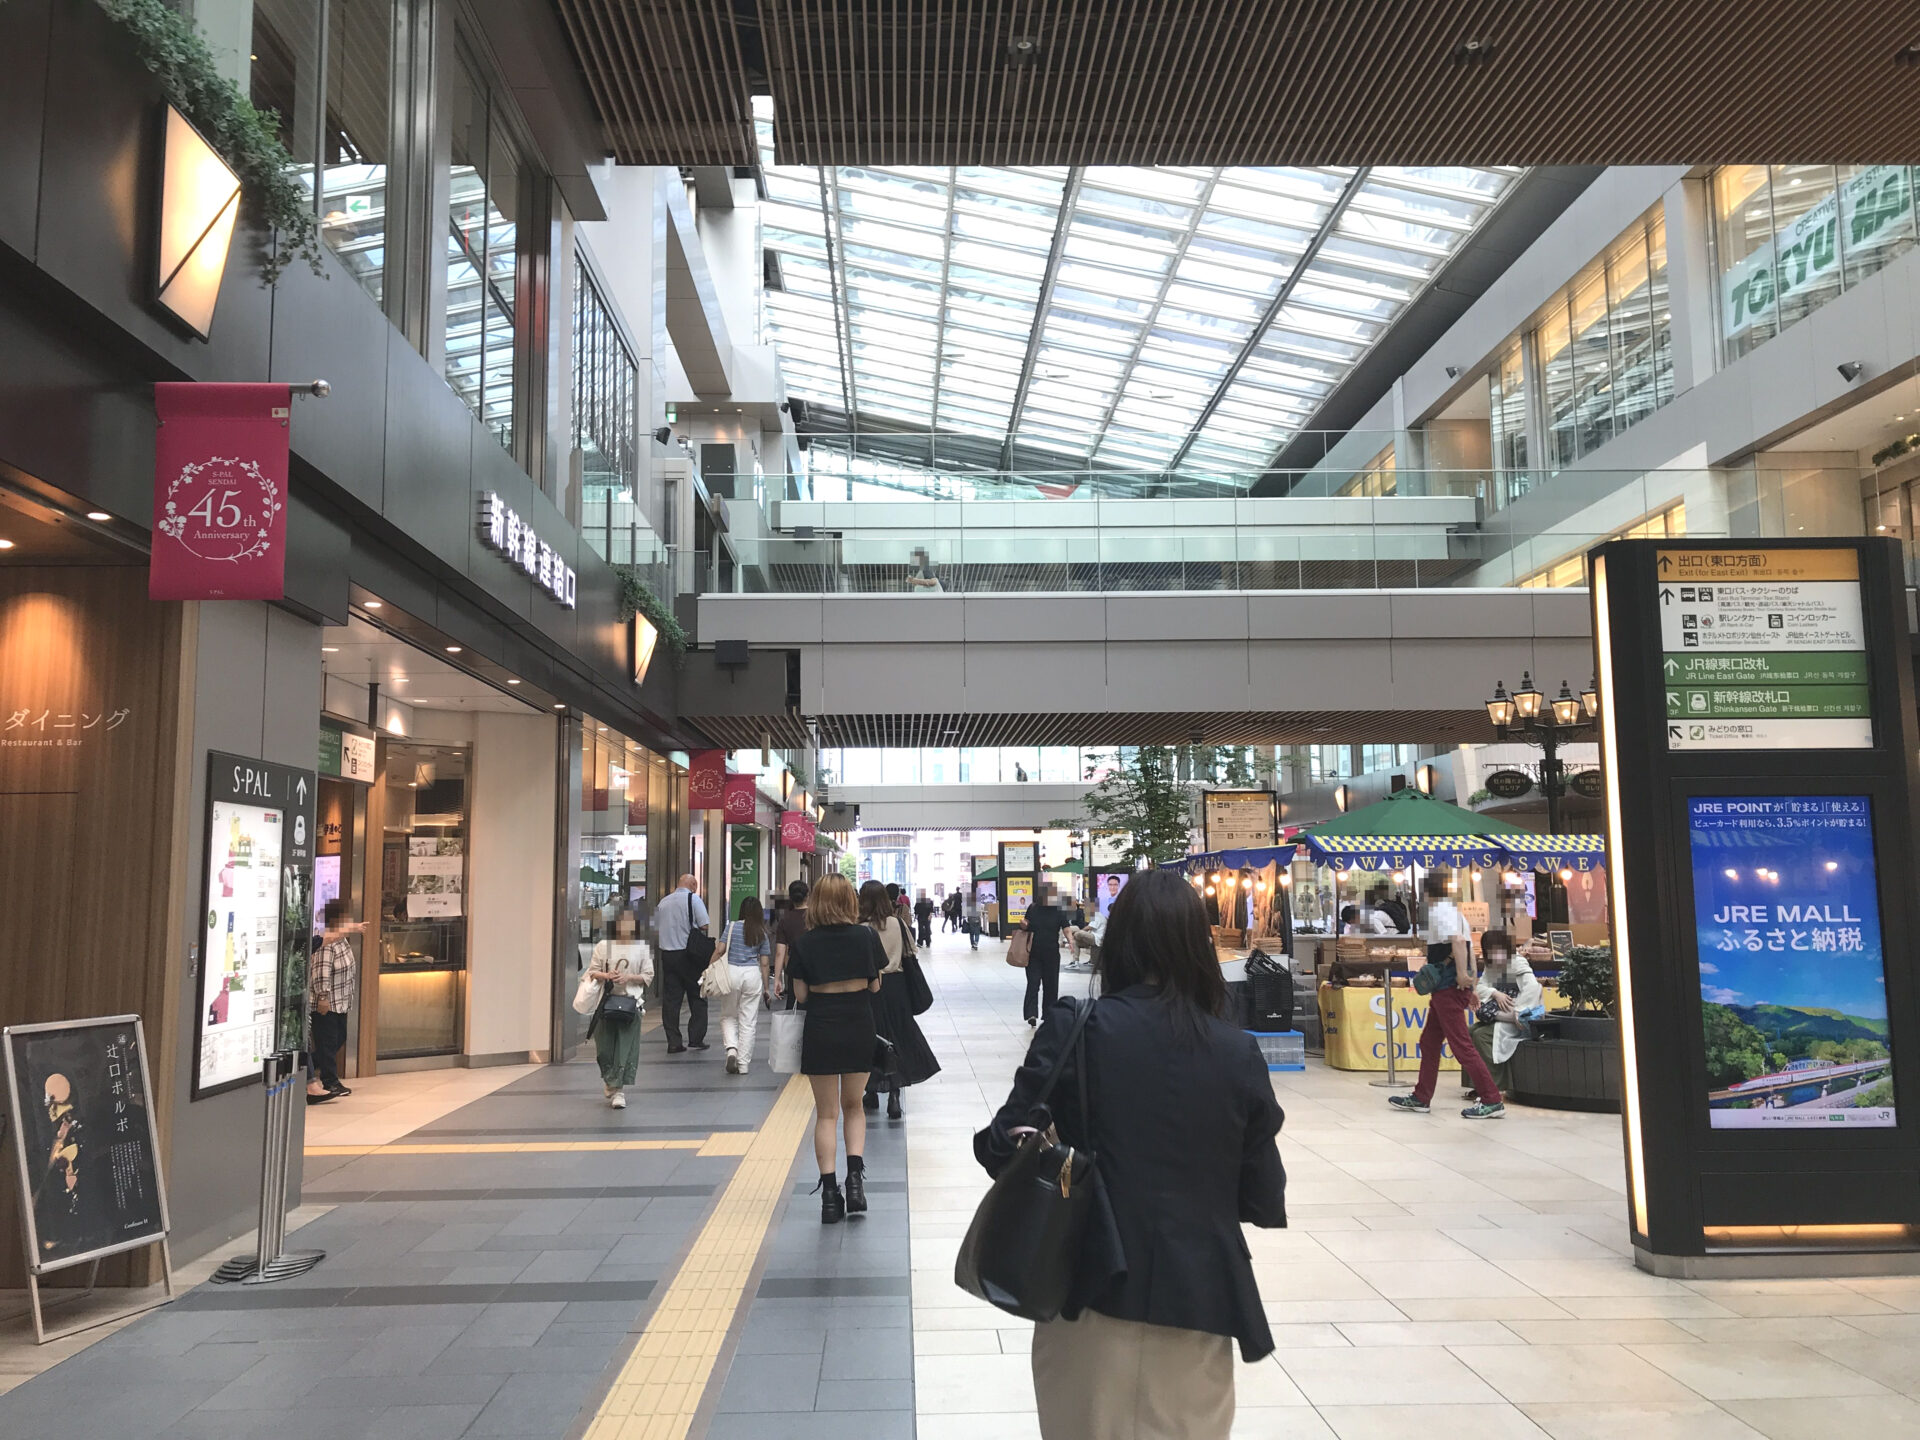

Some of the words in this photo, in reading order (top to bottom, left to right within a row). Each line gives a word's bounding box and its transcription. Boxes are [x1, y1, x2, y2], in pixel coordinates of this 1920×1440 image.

[1731, 216, 1837, 328] TOKYU
[187, 488, 257, 528] 45th
[193, 529, 250, 542] Anniversary
[489, 491, 576, 610] 新幹線連絡口
[1679, 568, 1694, 576] Exit
[1710, 568, 1729, 576] East
[1787, 613, 1837, 621] コインロッカー
[1685, 657, 1769, 671] JR線東口改札
[1685, 672, 1697, 680] JR
[1698, 672, 1715, 680] Line
[1716, 672, 1734, 680] East
[1736, 672, 1755, 680] Gate
[1713, 690, 1790, 703] 新幹線改札口
[1714, 705, 1758, 713] Shinkansen
[1759, 705, 1777, 713] Gate
[4, 708, 131, 732] ダイニング
[1708, 725, 1753, 733] みどりの窓口
[0, 739, 53, 747] Restaurant
[232, 765, 272, 798] S-PAL
[1694, 803, 1723, 814] JRE
[732, 858, 754, 871] JR
[1335, 853, 1492, 871] SWEETS
[1714, 905, 1769, 923] JRE
[1776, 905, 1861, 923] MALL
[1716, 926, 1864, 952] ふるさと納税
[106, 1043, 130, 1133] 辻口ボルポ
[1878, 1111, 1890, 1120] JR
